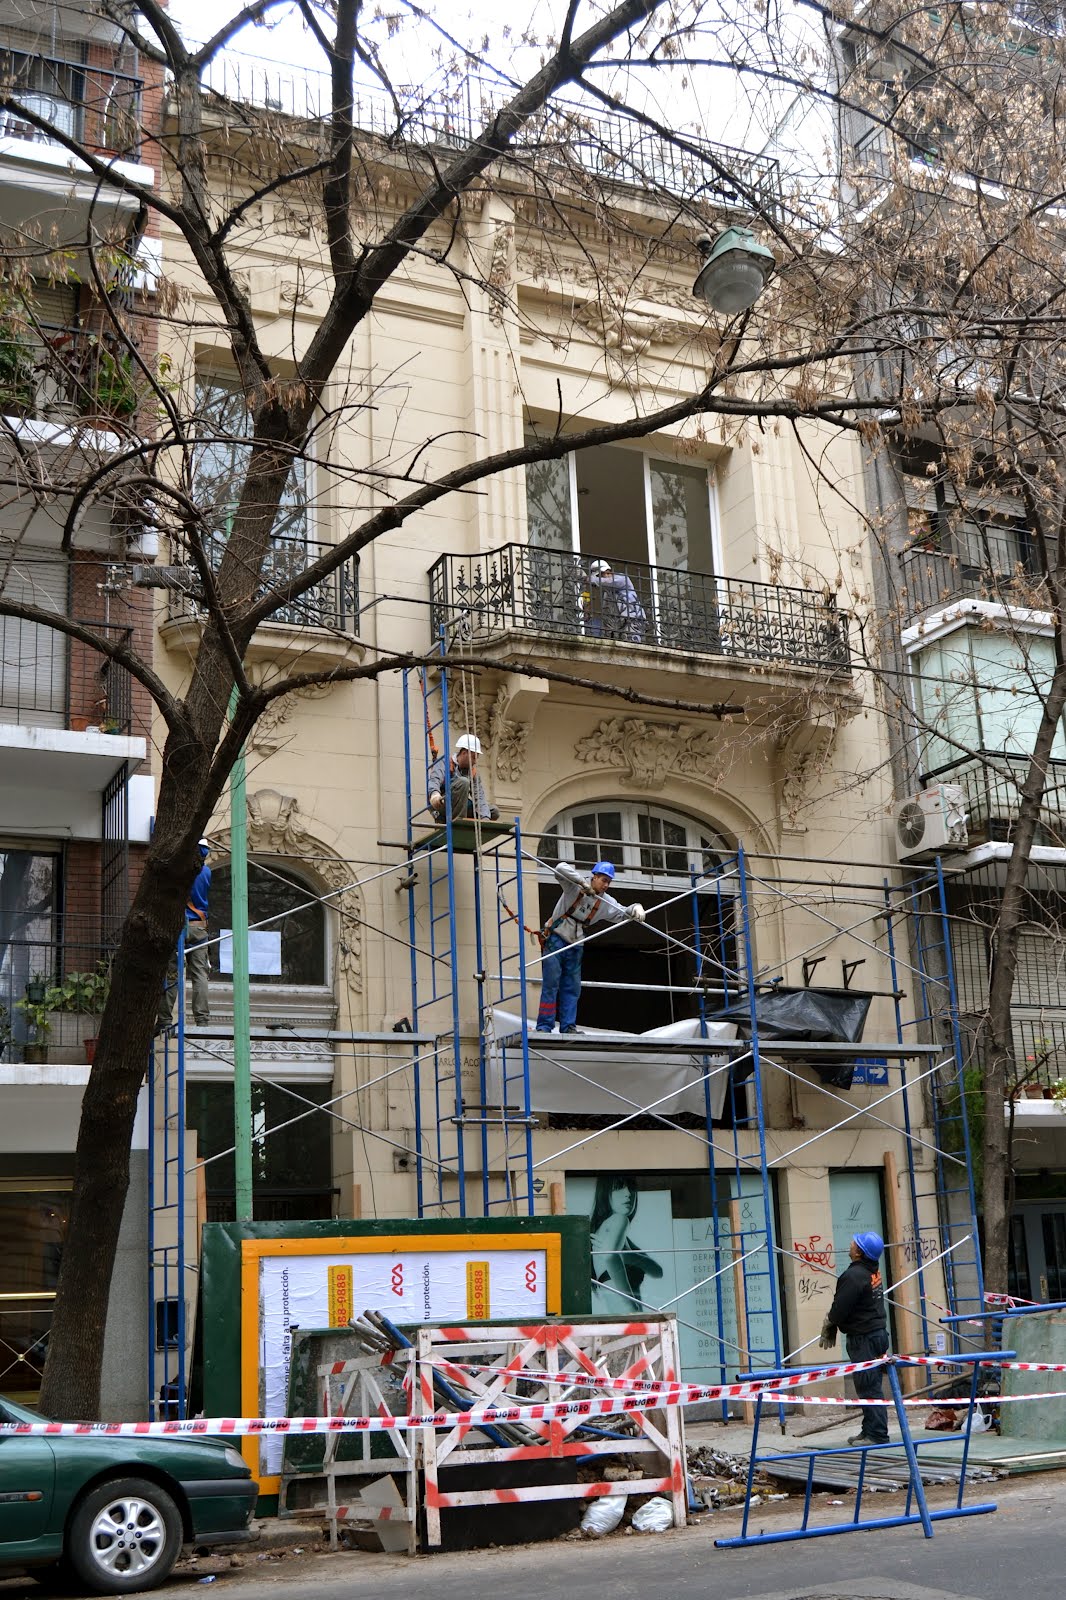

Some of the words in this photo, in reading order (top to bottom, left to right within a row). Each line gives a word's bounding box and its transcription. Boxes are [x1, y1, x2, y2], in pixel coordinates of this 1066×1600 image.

[742, 1202, 753, 1219] &
[281, 1266, 291, 1315] protección.
[423, 1262, 432, 1310] protección.
[474, 1269, 484, 1318] 88-9888
[282, 1318, 290, 1327] tu
[424, 1310, 431, 1320] tu
[282, 1335, 290, 1355] falta
[634, 1381, 660, 1390] PELIGRO
[79, 1423, 120, 1431] PELIGRO
[167, 1423, 206, 1431] PELIGRO
[251, 1420, 289, 1429] PELIGRO
[332, 1418, 368, 1427] PELIGRO
[410, 1415, 445, 1424] PELIGRO
[484, 1409, 519, 1419] PELIGRO
[557, 1404, 589, 1414] PELIGRO
[625, 1397, 656, 1408] PELIGRO
[690, 1389, 721, 1399] PELIGRO
